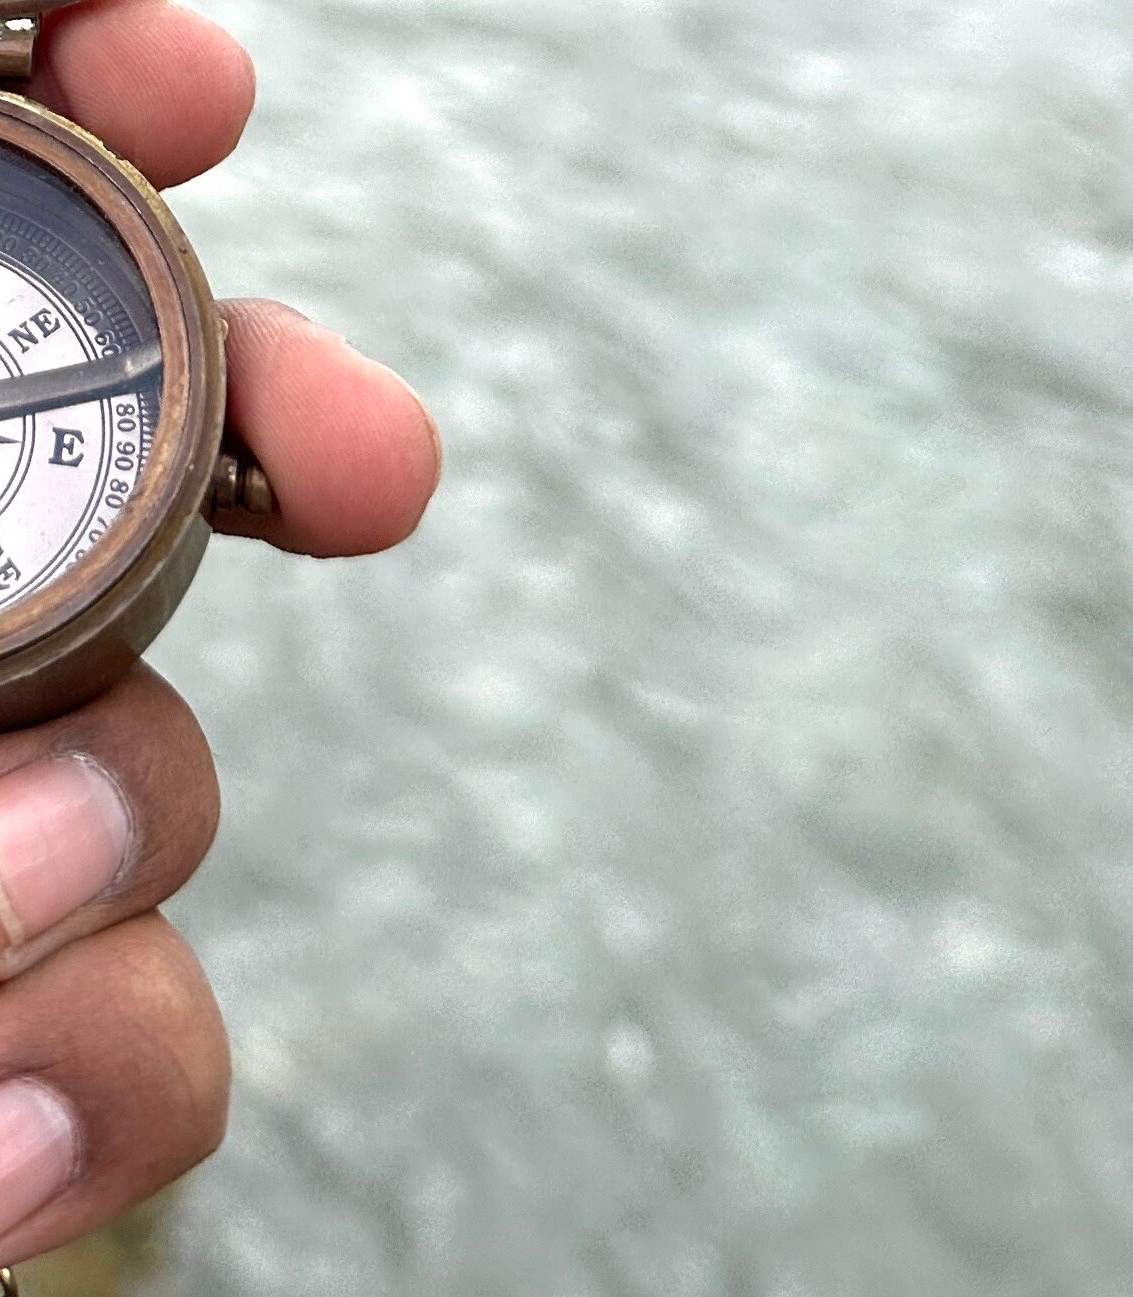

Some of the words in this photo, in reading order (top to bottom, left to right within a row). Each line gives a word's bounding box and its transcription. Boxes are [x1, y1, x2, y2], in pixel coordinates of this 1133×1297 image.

[7, 307, 61, 353] NE
[74, 299, 100, 326] 50
[95, 330, 122, 357] 60
[116, 403, 137, 432] 80
[48, 426, 84, 467] E
[114, 441, 136, 471] 90
[105, 478, 129, 509] 80
